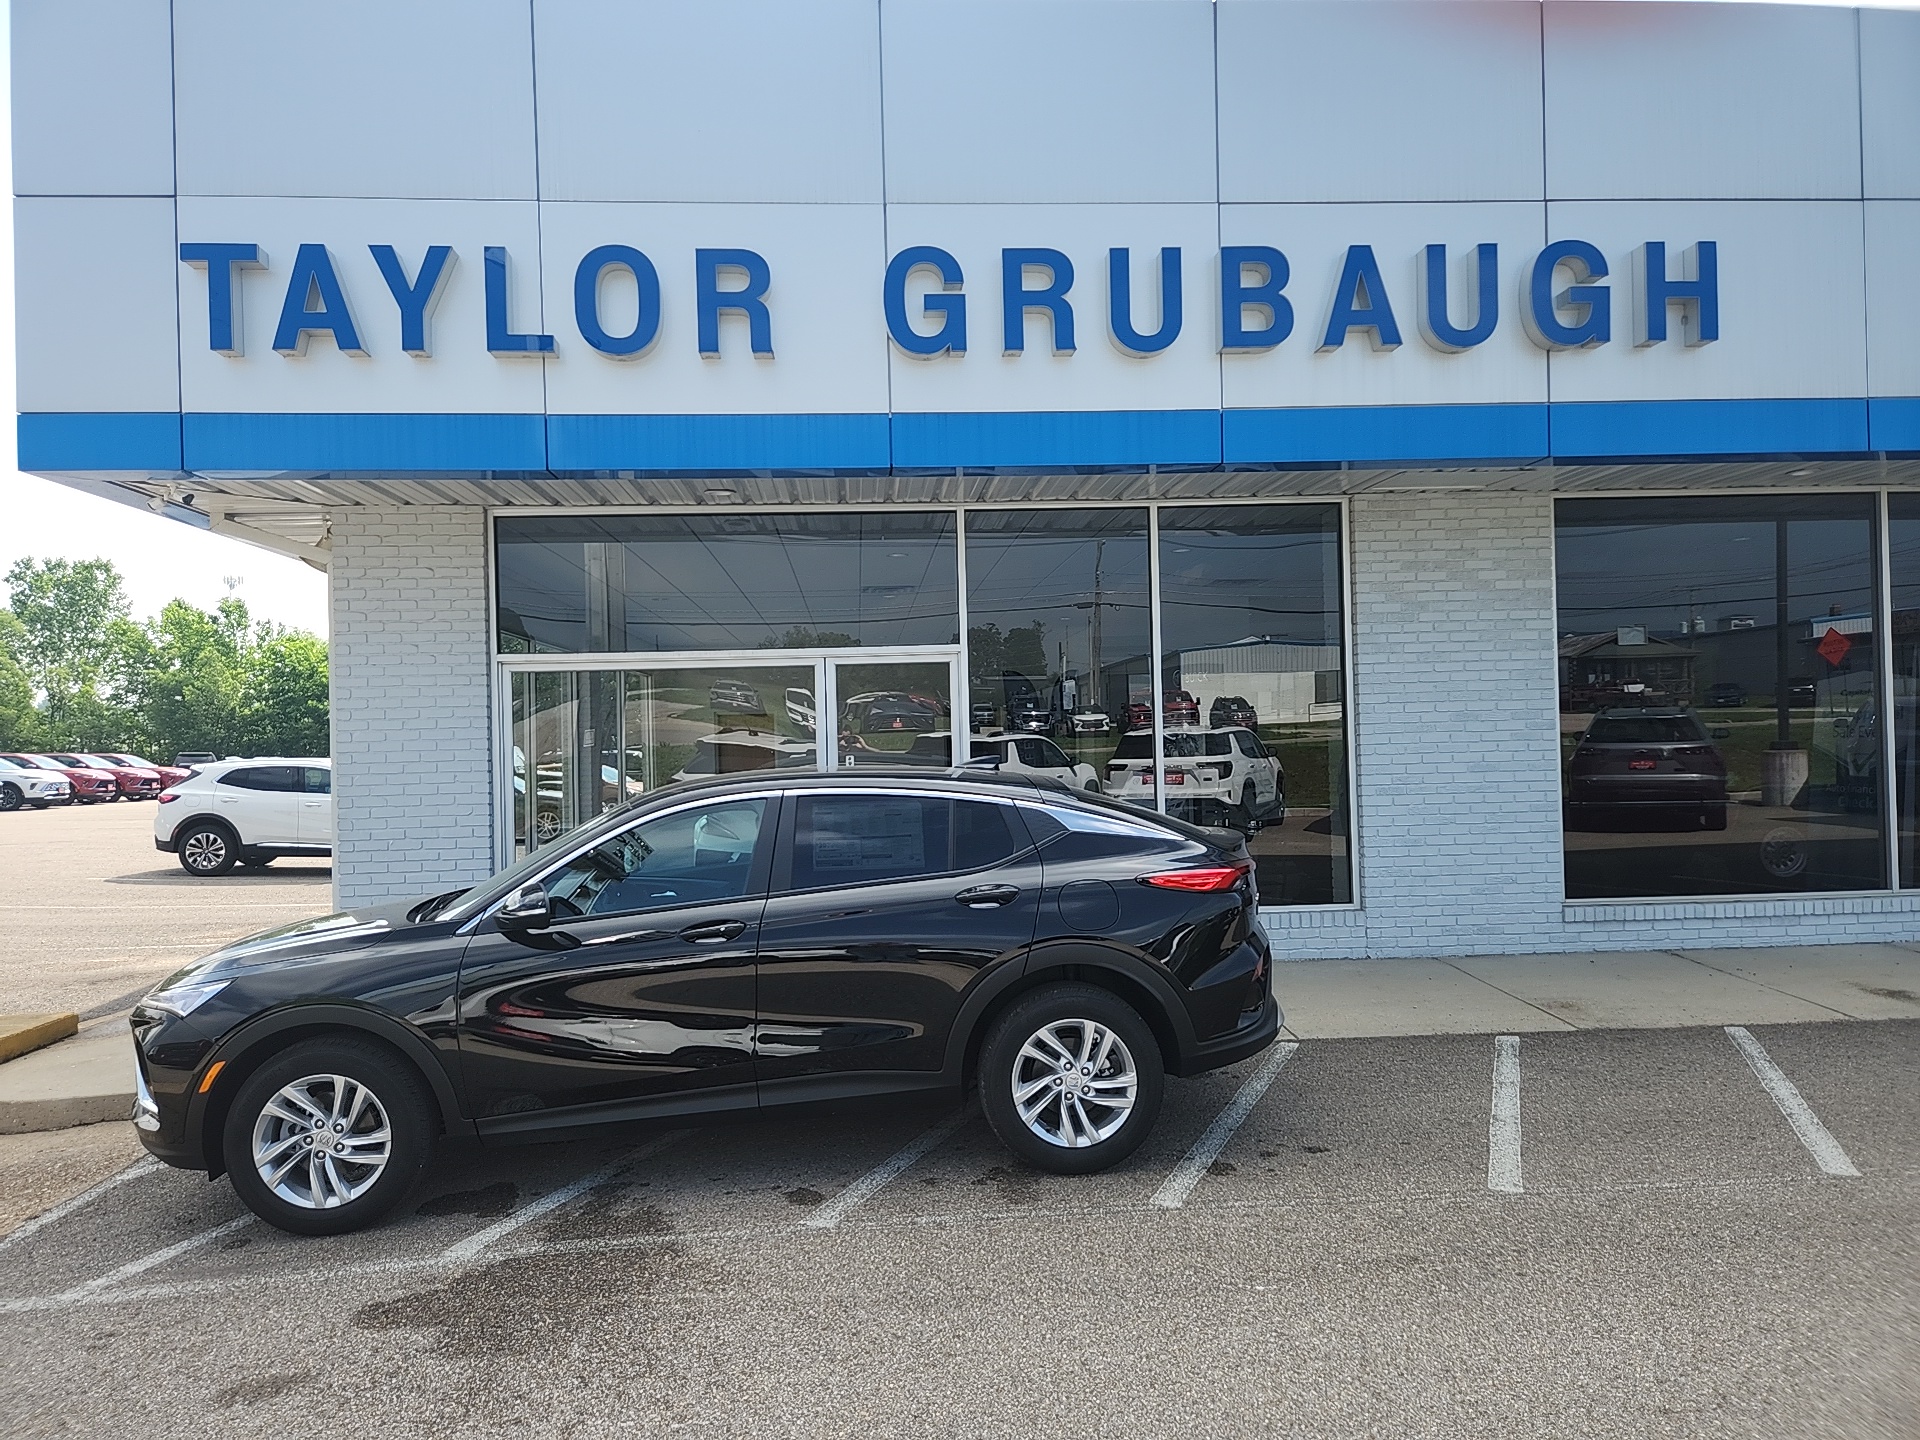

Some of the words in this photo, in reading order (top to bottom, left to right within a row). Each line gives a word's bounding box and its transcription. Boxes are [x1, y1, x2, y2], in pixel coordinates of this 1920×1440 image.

[180, 243, 775, 361] TAYLOR
[882, 240, 1720, 360] GRUBAUGH
[1184, 671, 1209, 683] BUCK
